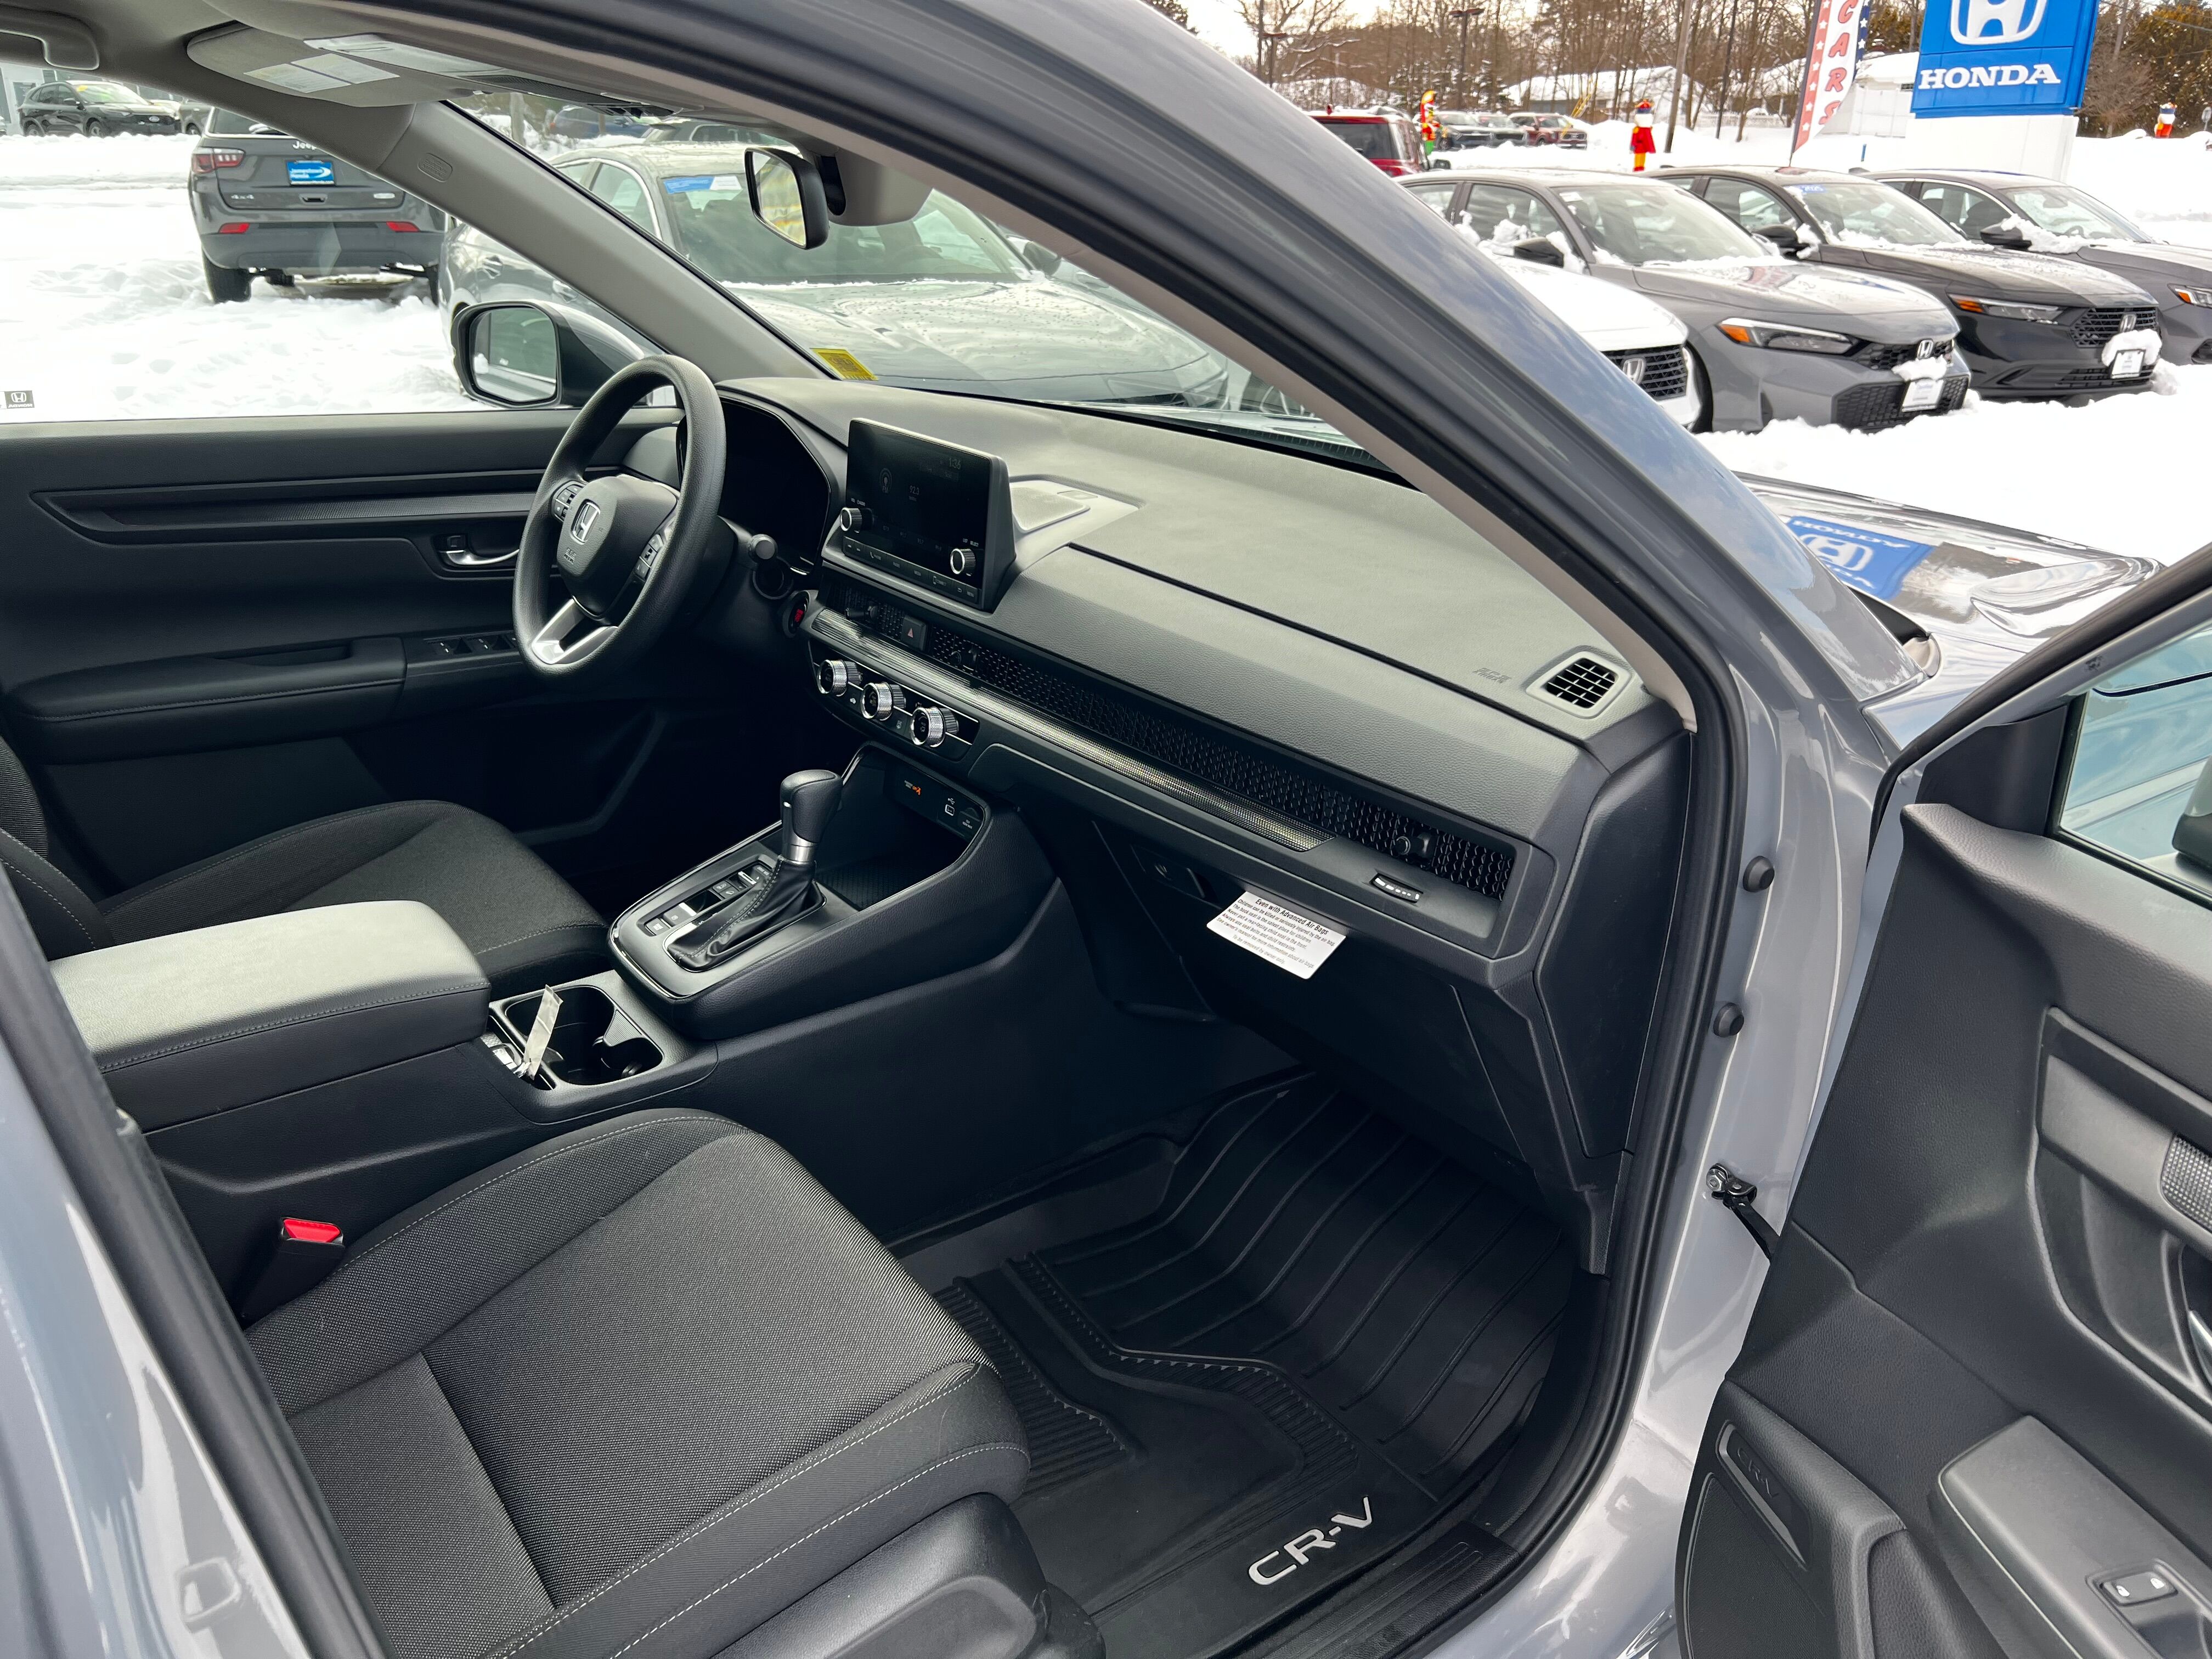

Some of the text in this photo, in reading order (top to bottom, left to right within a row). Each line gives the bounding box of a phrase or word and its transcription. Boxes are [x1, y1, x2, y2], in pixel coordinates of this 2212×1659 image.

[1818, 0, 1859, 125] CARS
[1918, 64, 2061, 89] HONDA
[1255, 899, 1269, 907] Even
[1280, 910, 1306, 924] Advanced
[1313, 925, 1329, 935] Bags
[1249, 1496, 1373, 1585] CR-V
